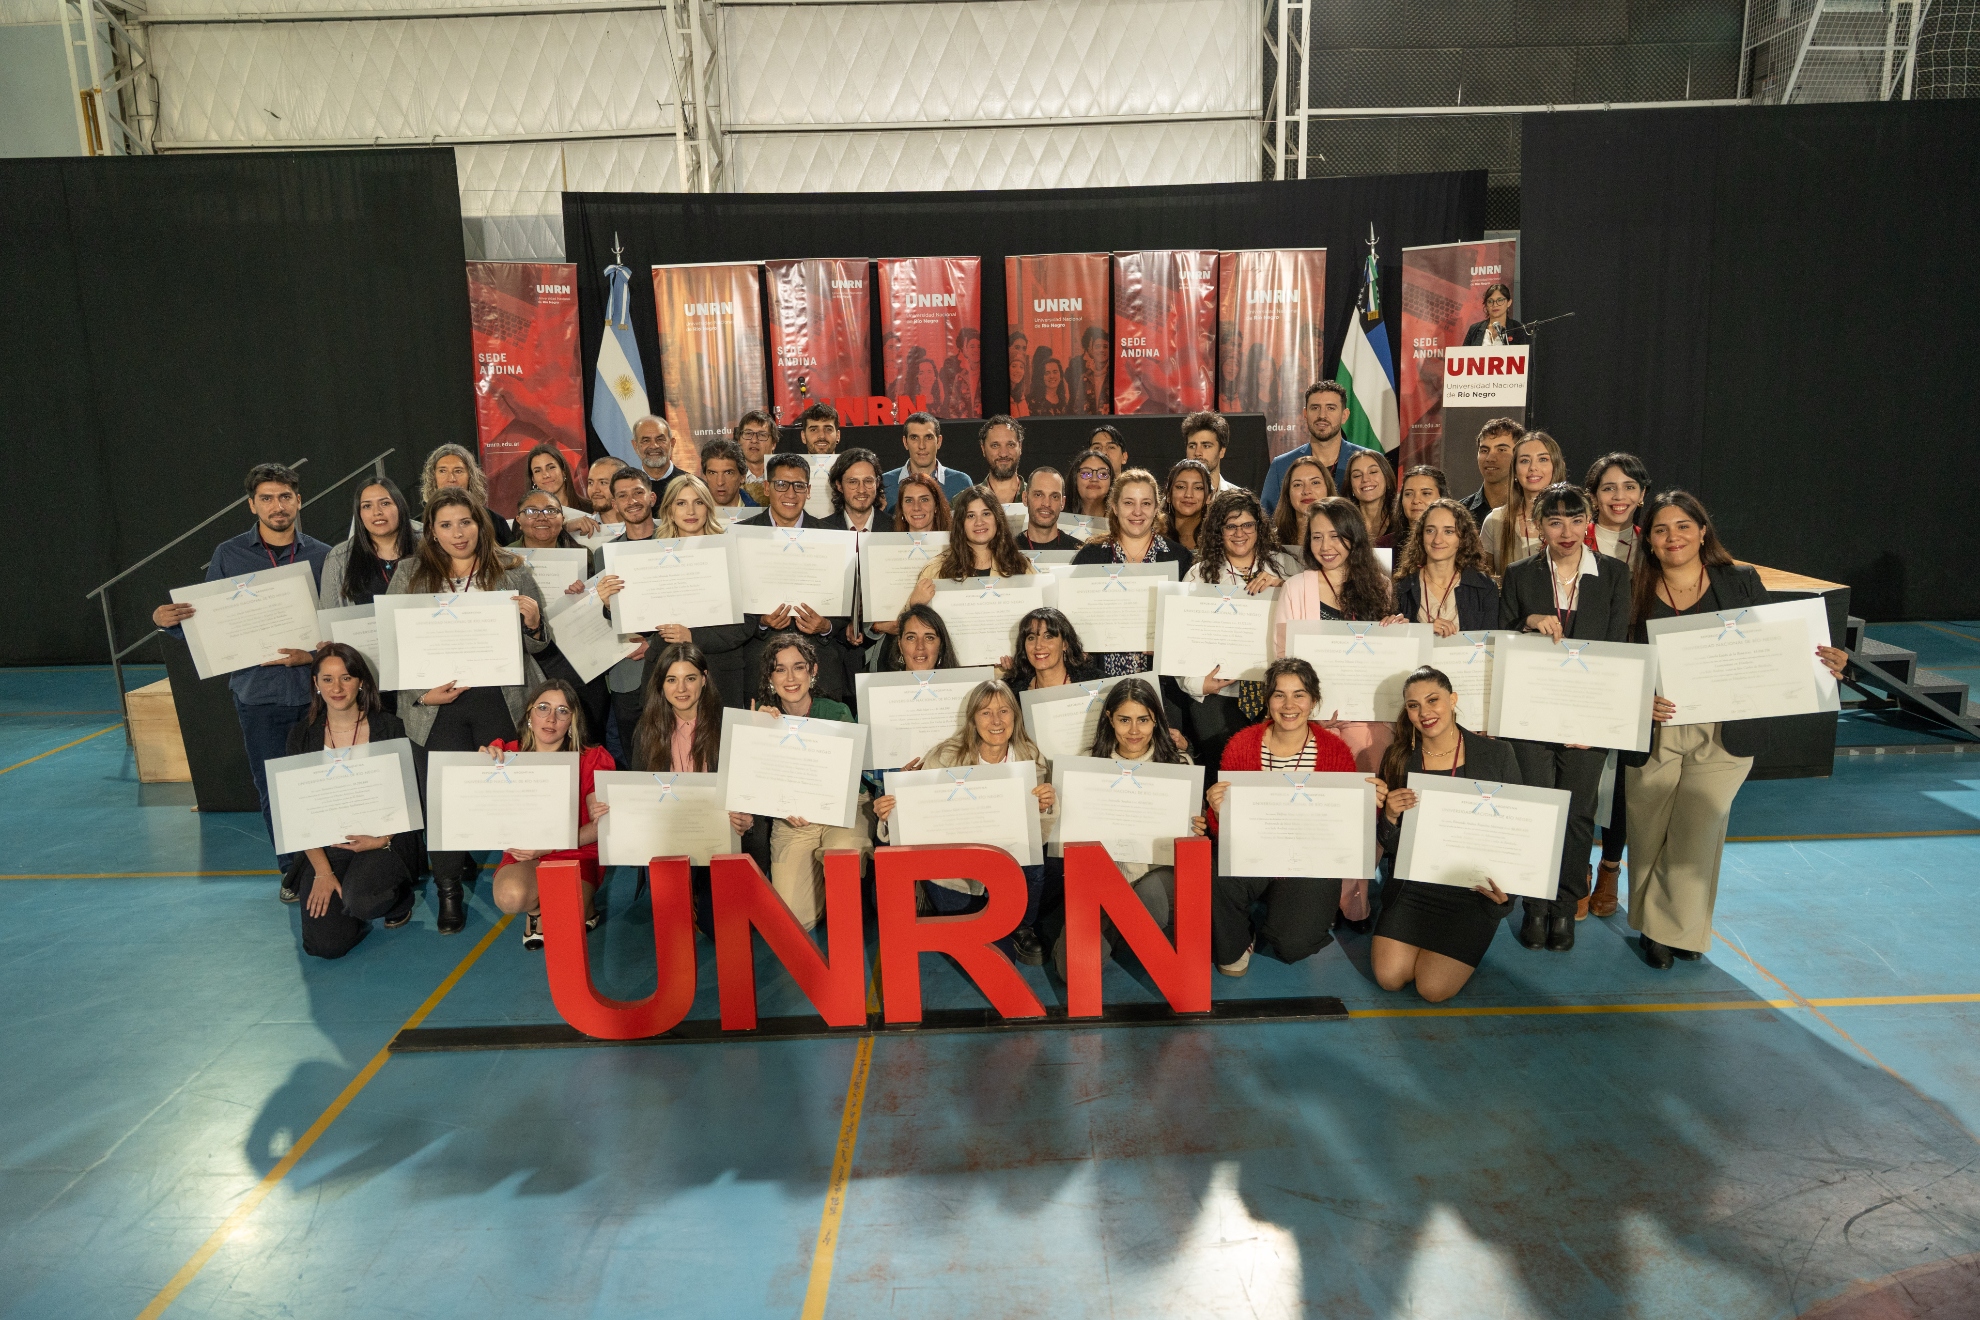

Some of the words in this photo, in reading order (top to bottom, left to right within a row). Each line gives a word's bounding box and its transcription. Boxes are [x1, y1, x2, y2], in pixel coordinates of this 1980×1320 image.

[1470, 265, 1502, 276] UNRN
[536, 284, 571, 294] UNRN
[832, 280, 862, 288] UNRN
[906, 294, 956, 307] UNRN
[1246, 289, 1299, 304] UNRN
[684, 302, 733, 316] UNRN
[1034, 298, 1082, 312] UNRN
[1121, 337, 1146, 346] SEDE
[1413, 337, 1438, 347] SEDE
[777, 345, 803, 355] SEDE
[1120, 348, 1160, 358] ANDINA
[1413, 349, 1444, 358] ANDIN
[478, 353, 507, 363] SEDE
[778, 357, 817, 367] ANDINA
[1447, 356, 1525, 376] UNRN
[694, 426, 734, 436] unrn.edu.
[1267, 422, 1296, 431] edu.ar
[536, 836, 1213, 1040] UNRN
